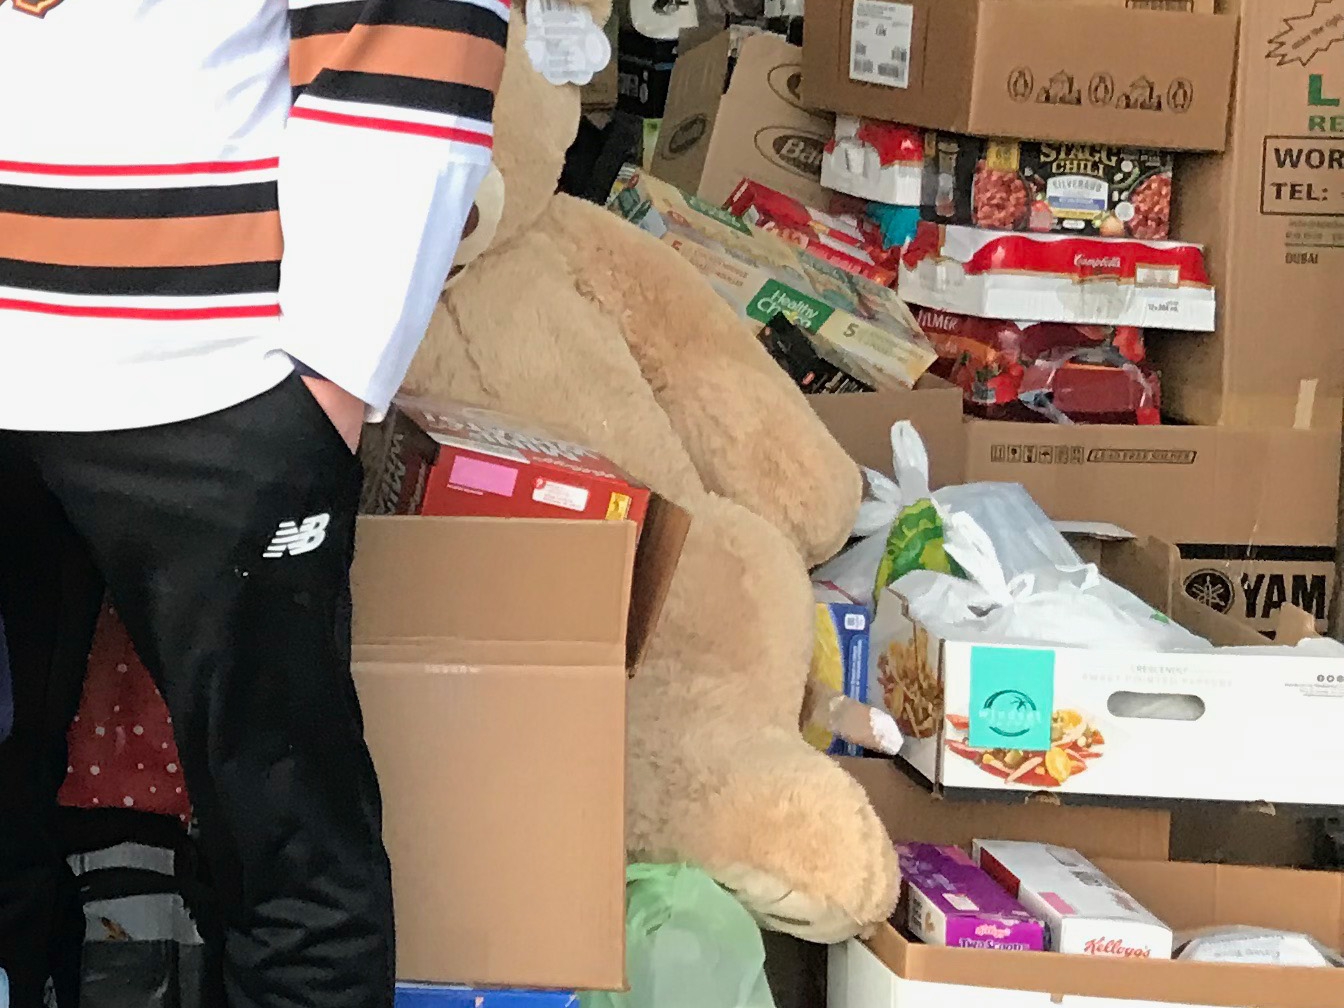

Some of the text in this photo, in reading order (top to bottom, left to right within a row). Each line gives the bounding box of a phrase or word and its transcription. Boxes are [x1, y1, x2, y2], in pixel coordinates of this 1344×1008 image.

[1052, 159, 1105, 179] CHILI
[1270, 182, 1330, 202] TEL:
[756, 295, 812, 329] Chce
[771, 289, 820, 319] Healthy
[1240, 572, 1327, 619] YAM
